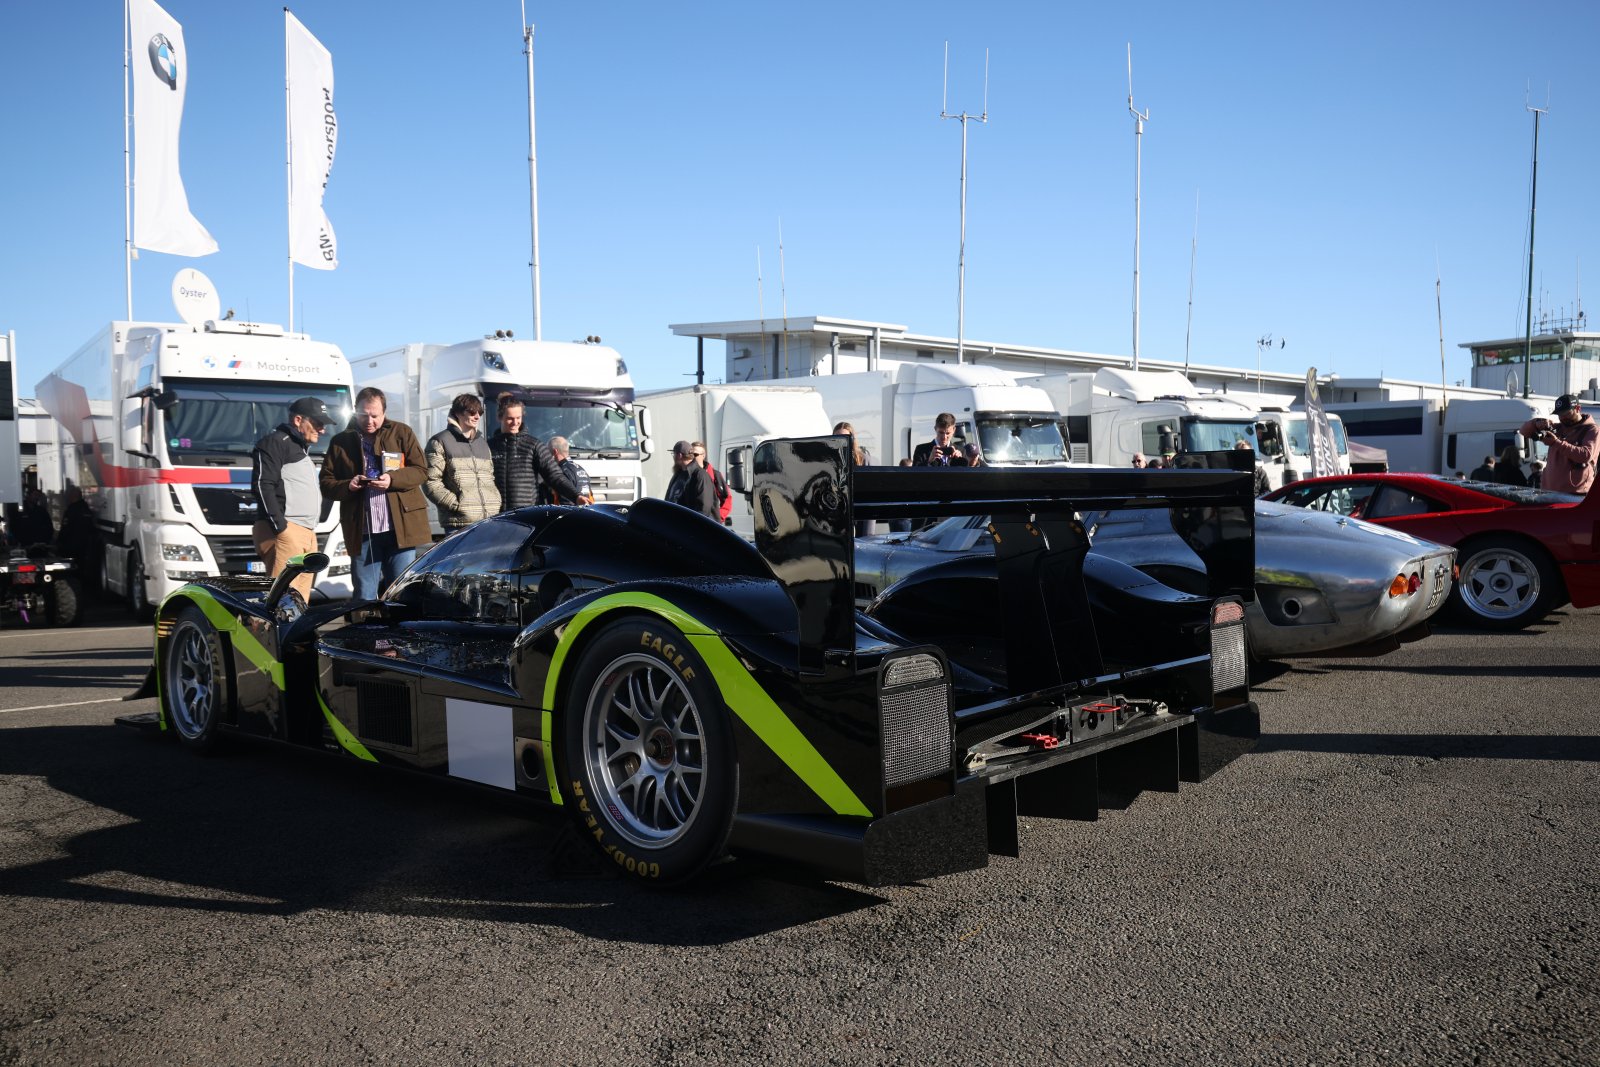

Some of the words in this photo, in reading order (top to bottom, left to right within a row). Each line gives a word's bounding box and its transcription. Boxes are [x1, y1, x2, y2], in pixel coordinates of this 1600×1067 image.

[180, 286, 207, 298] Oyster
[257, 361, 320, 374] Motorsport
[640, 631, 696, 682] EAGLE
[572, 780, 660, 878] GOODYEAR
